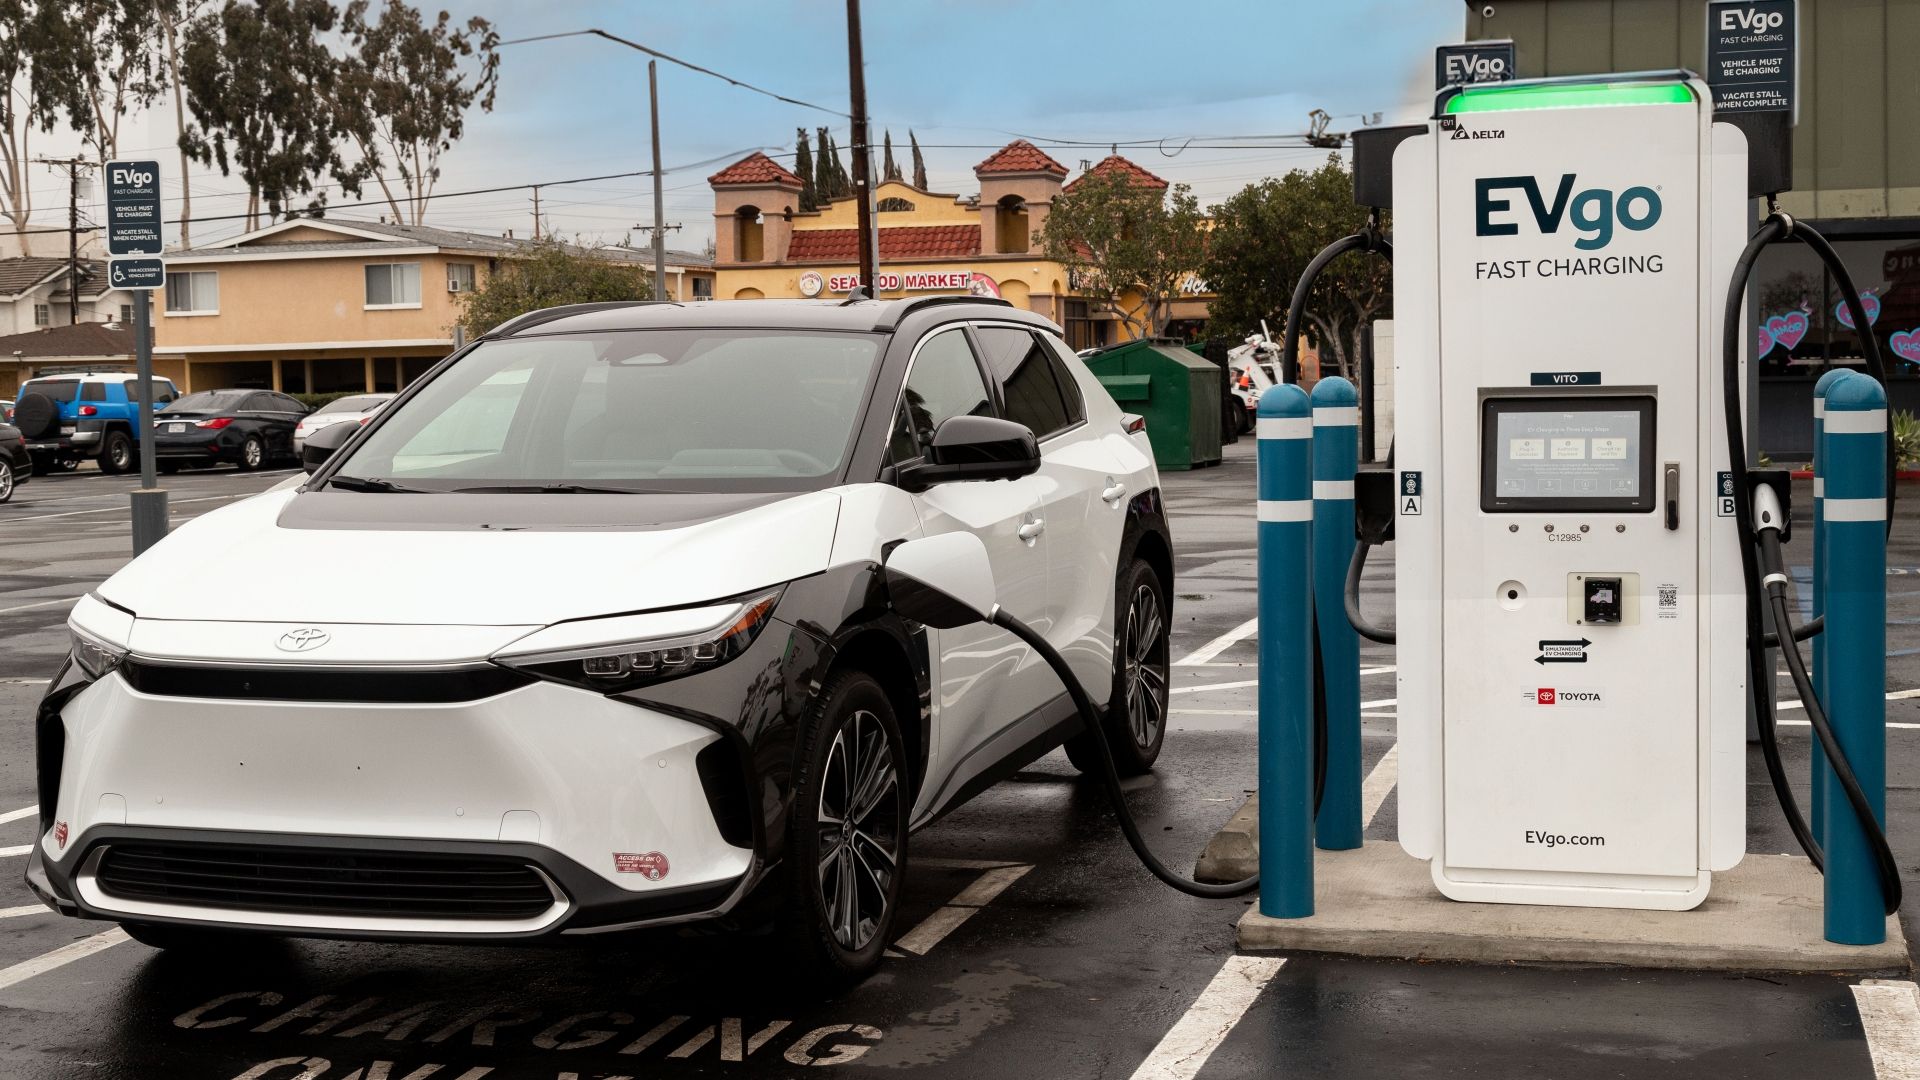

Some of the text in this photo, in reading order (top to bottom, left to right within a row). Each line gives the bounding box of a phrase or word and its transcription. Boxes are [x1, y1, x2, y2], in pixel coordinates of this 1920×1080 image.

[1720, 8, 1783, 34] EVgo
[1720, 34, 1783, 45] FAST CHARGING
[1721, 58, 1783, 68] VEHICLE MUST
[1735, 66, 1780, 75] CHARGING
[1722, 90, 1781, 100] VACATE STALL
[1717, 98, 1788, 109] WHEN COMPLETE
[1472, 130, 1505, 139] DELTA
[113, 169, 153, 188] EVgo
[1476, 254, 1664, 279] FAST CHARGING
[830, 274, 967, 290] SEAOD MARKET
[1553, 374, 1578, 384] VITO
[1405, 498, 1417, 512] A
[1723, 499, 1734, 513] B
[1548, 533, 1581, 542] C12985
[1558, 692, 1601, 702] TOYOTA
[1525, 830, 1605, 848] EVgo.com
[172, 990, 884, 1067] CHARGING
